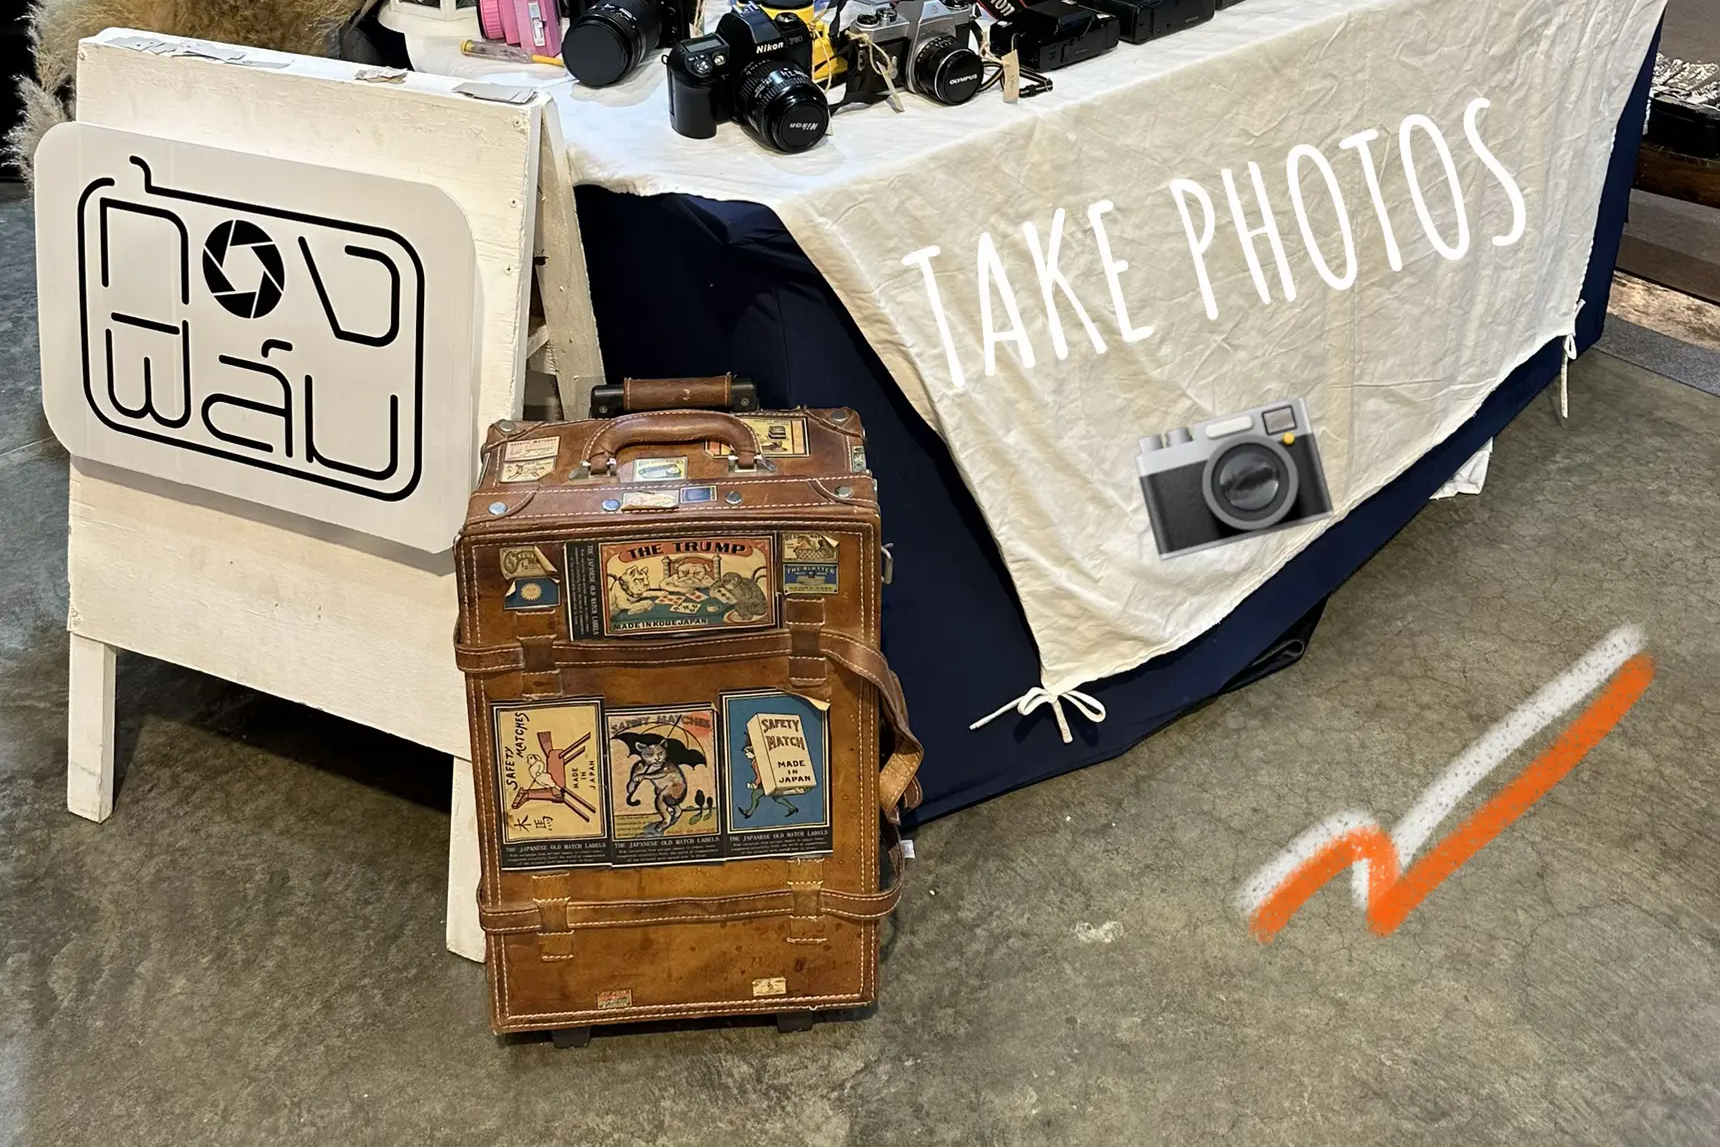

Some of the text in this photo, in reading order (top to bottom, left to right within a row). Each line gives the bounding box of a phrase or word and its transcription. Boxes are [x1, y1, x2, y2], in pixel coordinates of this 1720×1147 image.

[756, 41, 784, 54] Nikon
[949, 72, 978, 85] OLYMPUS
[789, 122, 819, 131] Nikon
[628, 541, 746, 559] THE TRUMP
[613, 622, 640, 630] MADE
[677, 618, 707, 626] JAPAN
[610, 716, 650, 735] SAFETY
[761, 718, 800, 733] SAFETY
[514, 712, 530, 758] MATCHES
[765, 734, 806, 751] MATCH
[505, 746, 518, 790] SAFETY
[778, 760, 806, 768] MADE
[581, 771, 586, 780] IN
[779, 775, 811, 783] JAPAN
